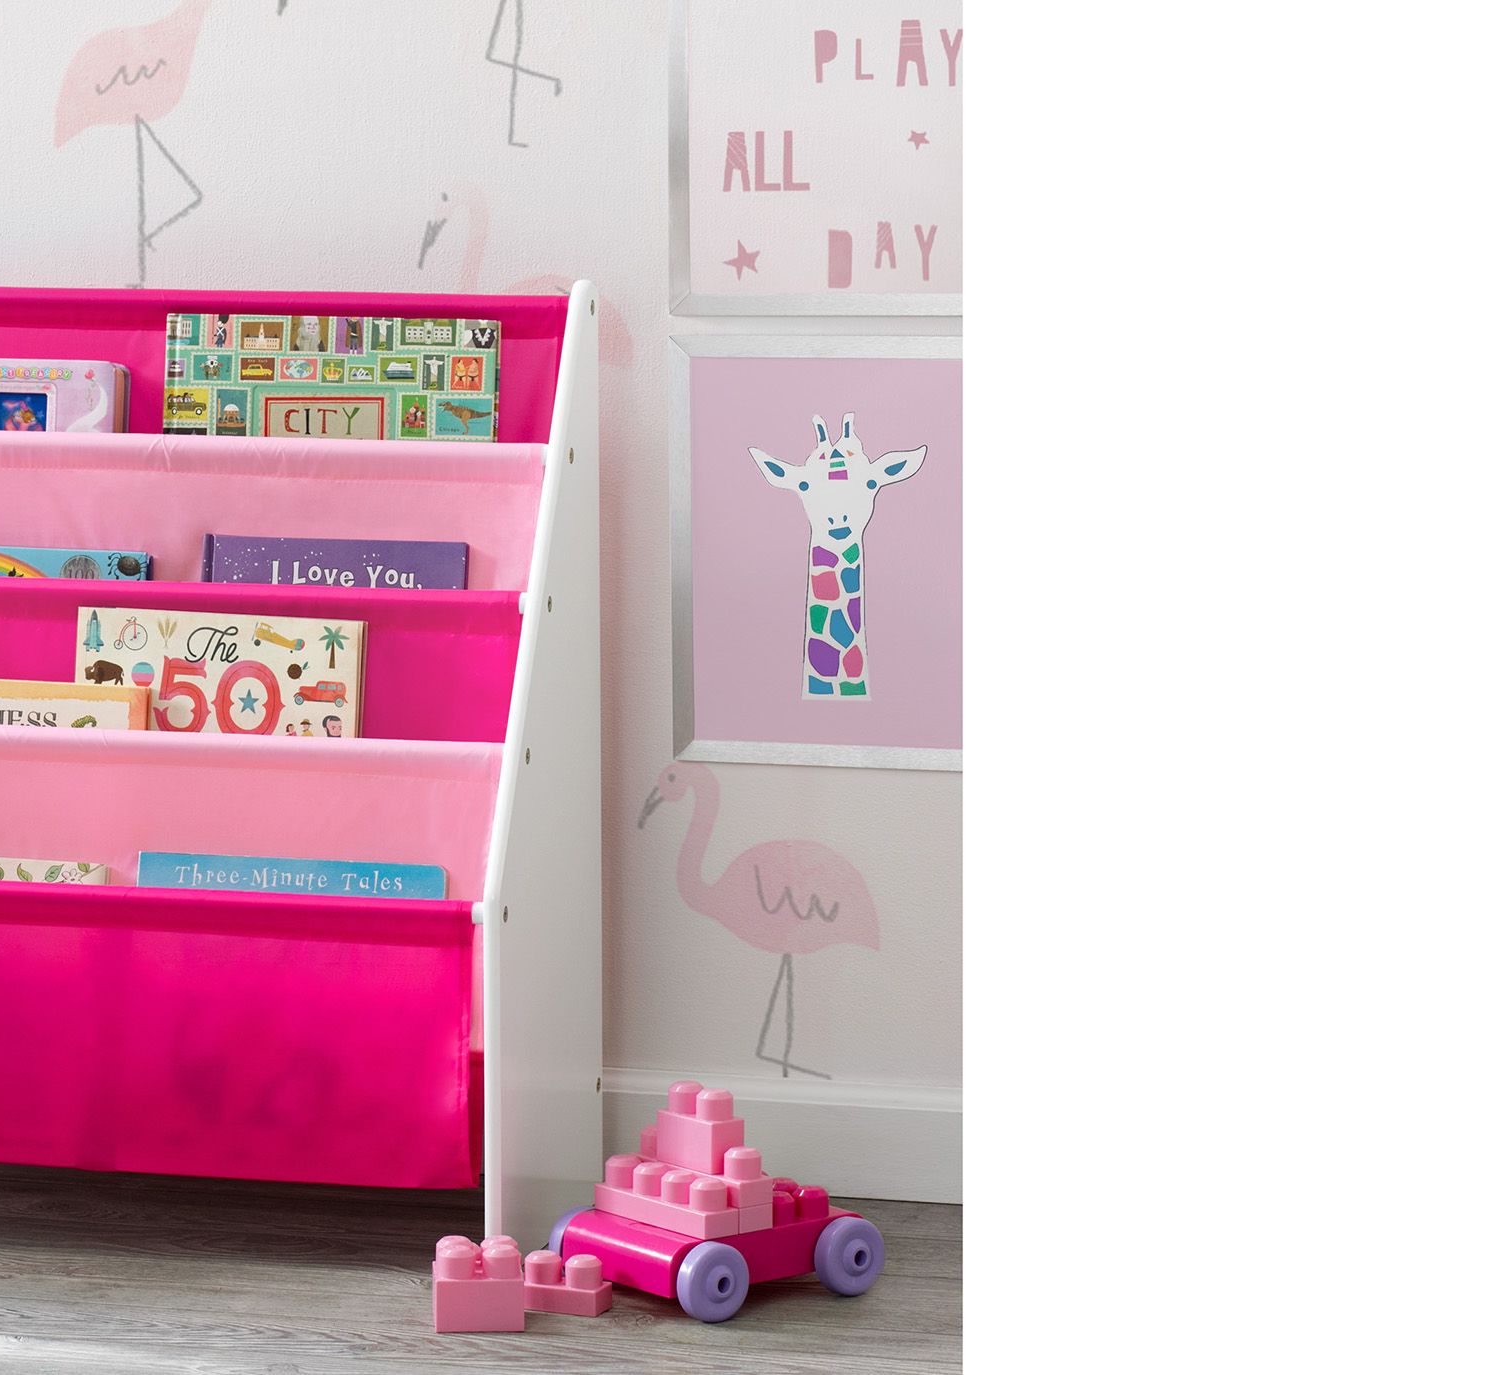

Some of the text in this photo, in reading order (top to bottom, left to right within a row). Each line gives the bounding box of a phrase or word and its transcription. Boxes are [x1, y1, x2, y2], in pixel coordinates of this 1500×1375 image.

[813, 19, 963, 87] PLAY
[722, 130, 811, 192] ALL
[827, 221, 938, 289] DAY
[284, 407, 360, 435] CITY
[272, 560, 423, 590] I Love You,
[184, 626, 239, 663] The
[153, 655, 286, 735] 50
[175, 863, 404, 893] Three-Minute Tales
